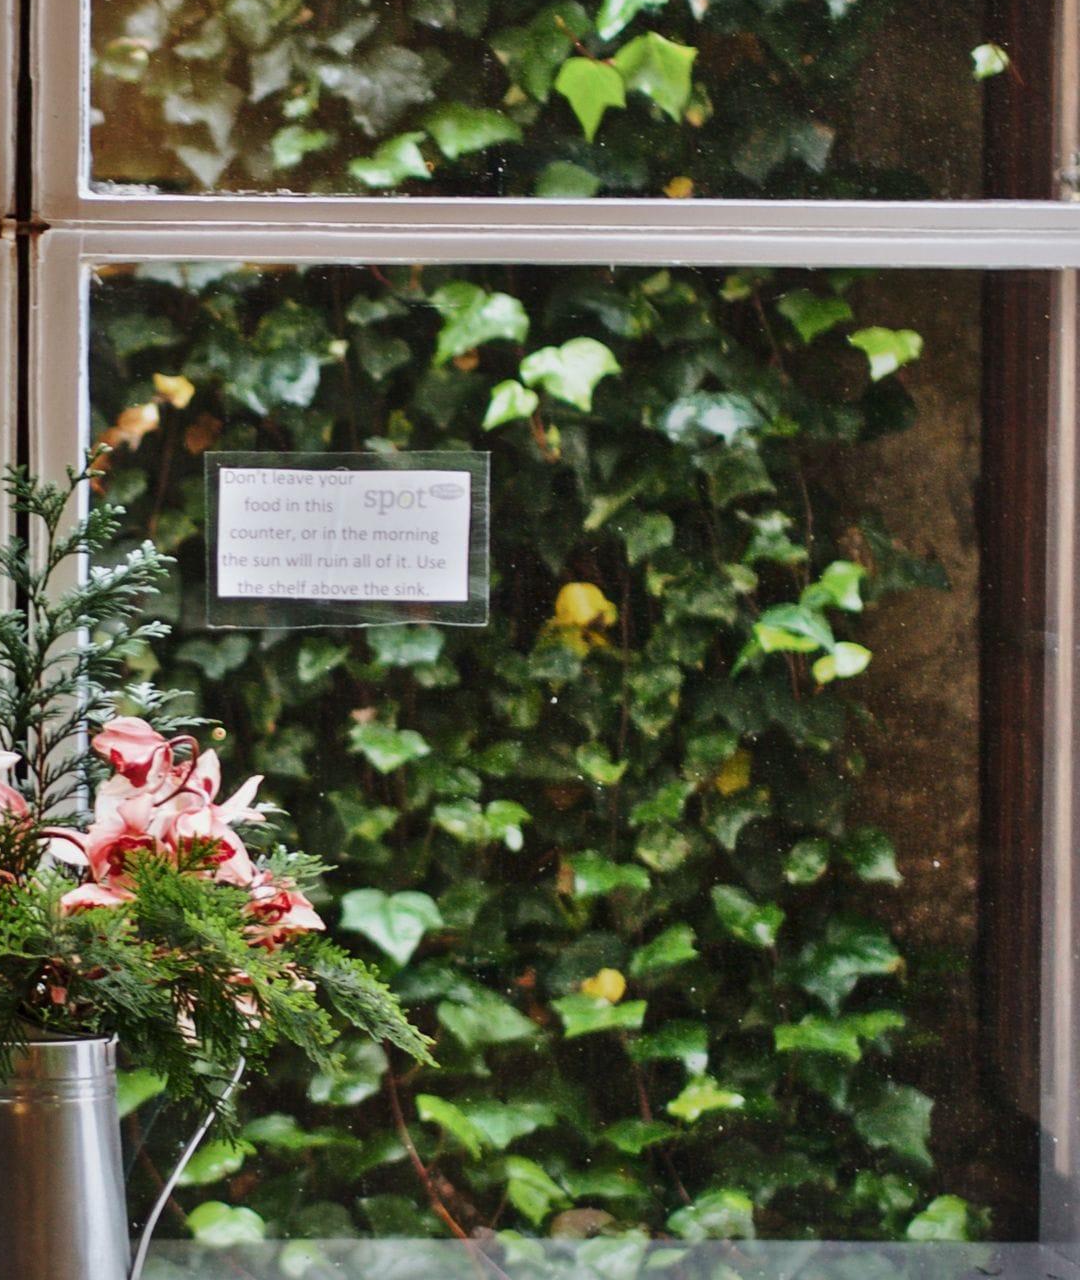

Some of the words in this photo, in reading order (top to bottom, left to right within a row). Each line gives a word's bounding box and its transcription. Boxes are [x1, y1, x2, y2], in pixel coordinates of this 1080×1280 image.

[224, 470, 267, 484] Don't
[272, 471, 313, 485] leave
[320, 473, 354, 486] your
[244, 498, 280, 512] food
[286, 498, 300, 512] in
[305, 498, 333, 513] this
[363, 488, 427, 515] spot
[230, 527, 296, 542] counter,
[301, 530, 318, 540] or
[322, 527, 336, 540] in
[342, 527, 366, 541] the
[372, 527, 439, 544] morning
[222, 553, 248, 567] the
[254, 557, 280, 567] sun
[286, 553, 312, 567] will
[318, 555, 347, 568] ruin
[353, 554, 370, 568] all
[376, 554, 392, 569] of
[395, 554, 411, 569] it.
[417, 556, 446, 570] Use
[238, 580, 263, 595] the
[269, 581, 306, 595] shelf
[313, 582, 358, 596] above
[363, 582, 388, 596] the
[394, 582, 430, 597] sink.
